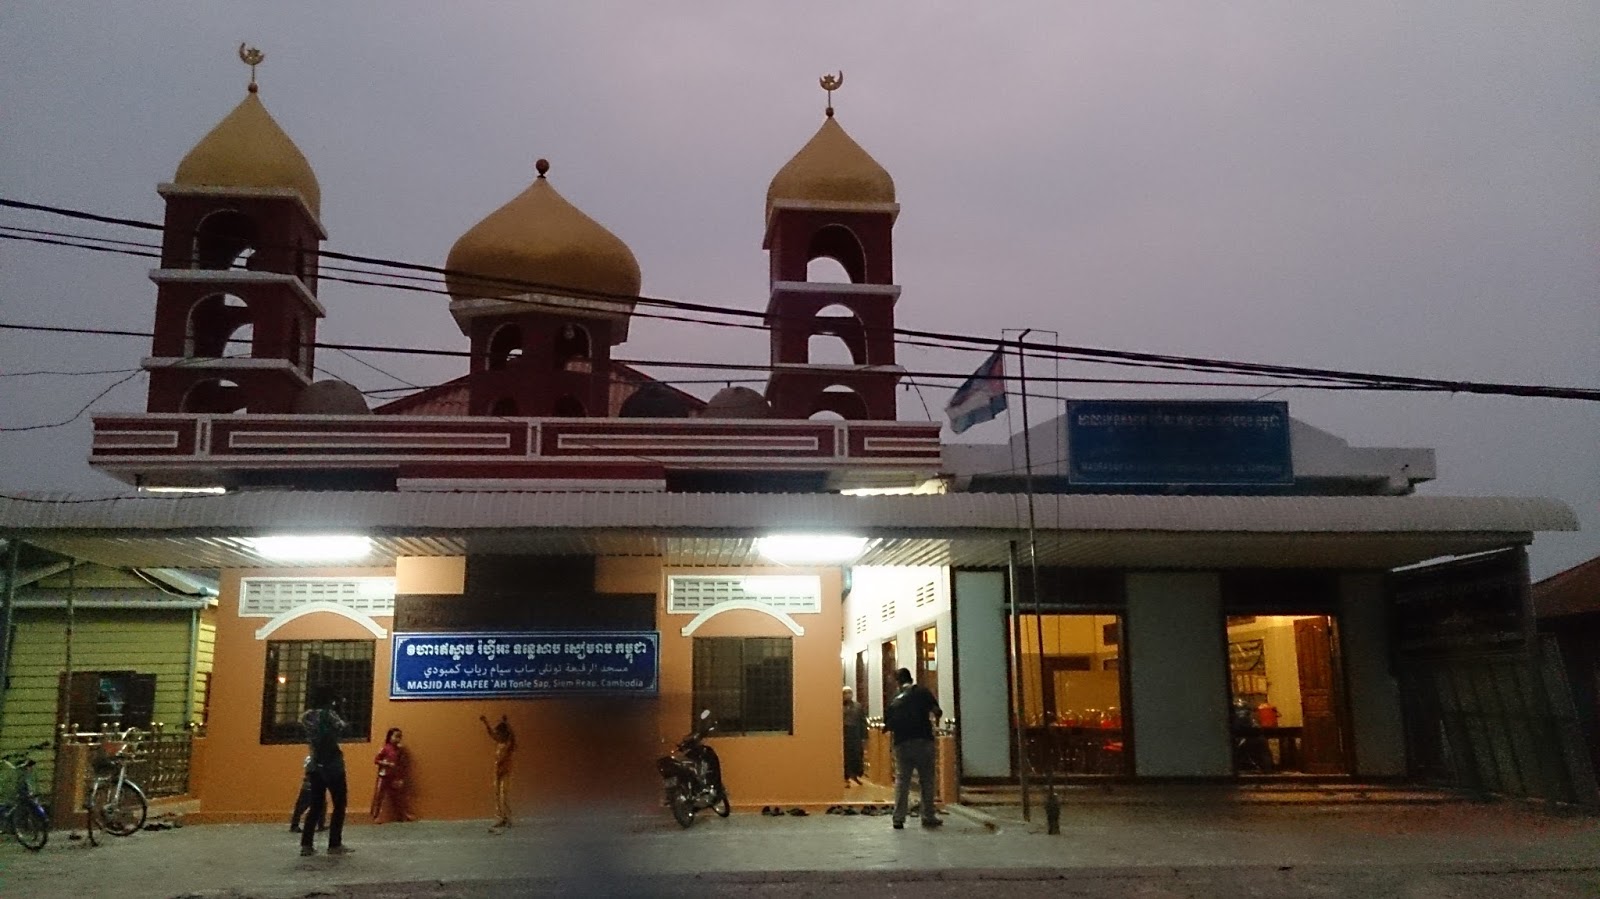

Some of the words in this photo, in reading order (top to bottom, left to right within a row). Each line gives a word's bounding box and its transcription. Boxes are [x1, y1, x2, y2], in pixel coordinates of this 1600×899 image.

[407, 681, 442, 689] MASJID
[444, 680, 489, 689] AR-RAFEE
[509, 679, 532, 688] Tonle
[553, 679, 575, 688] Siem
[601, 678, 644, 688] Cambodia
